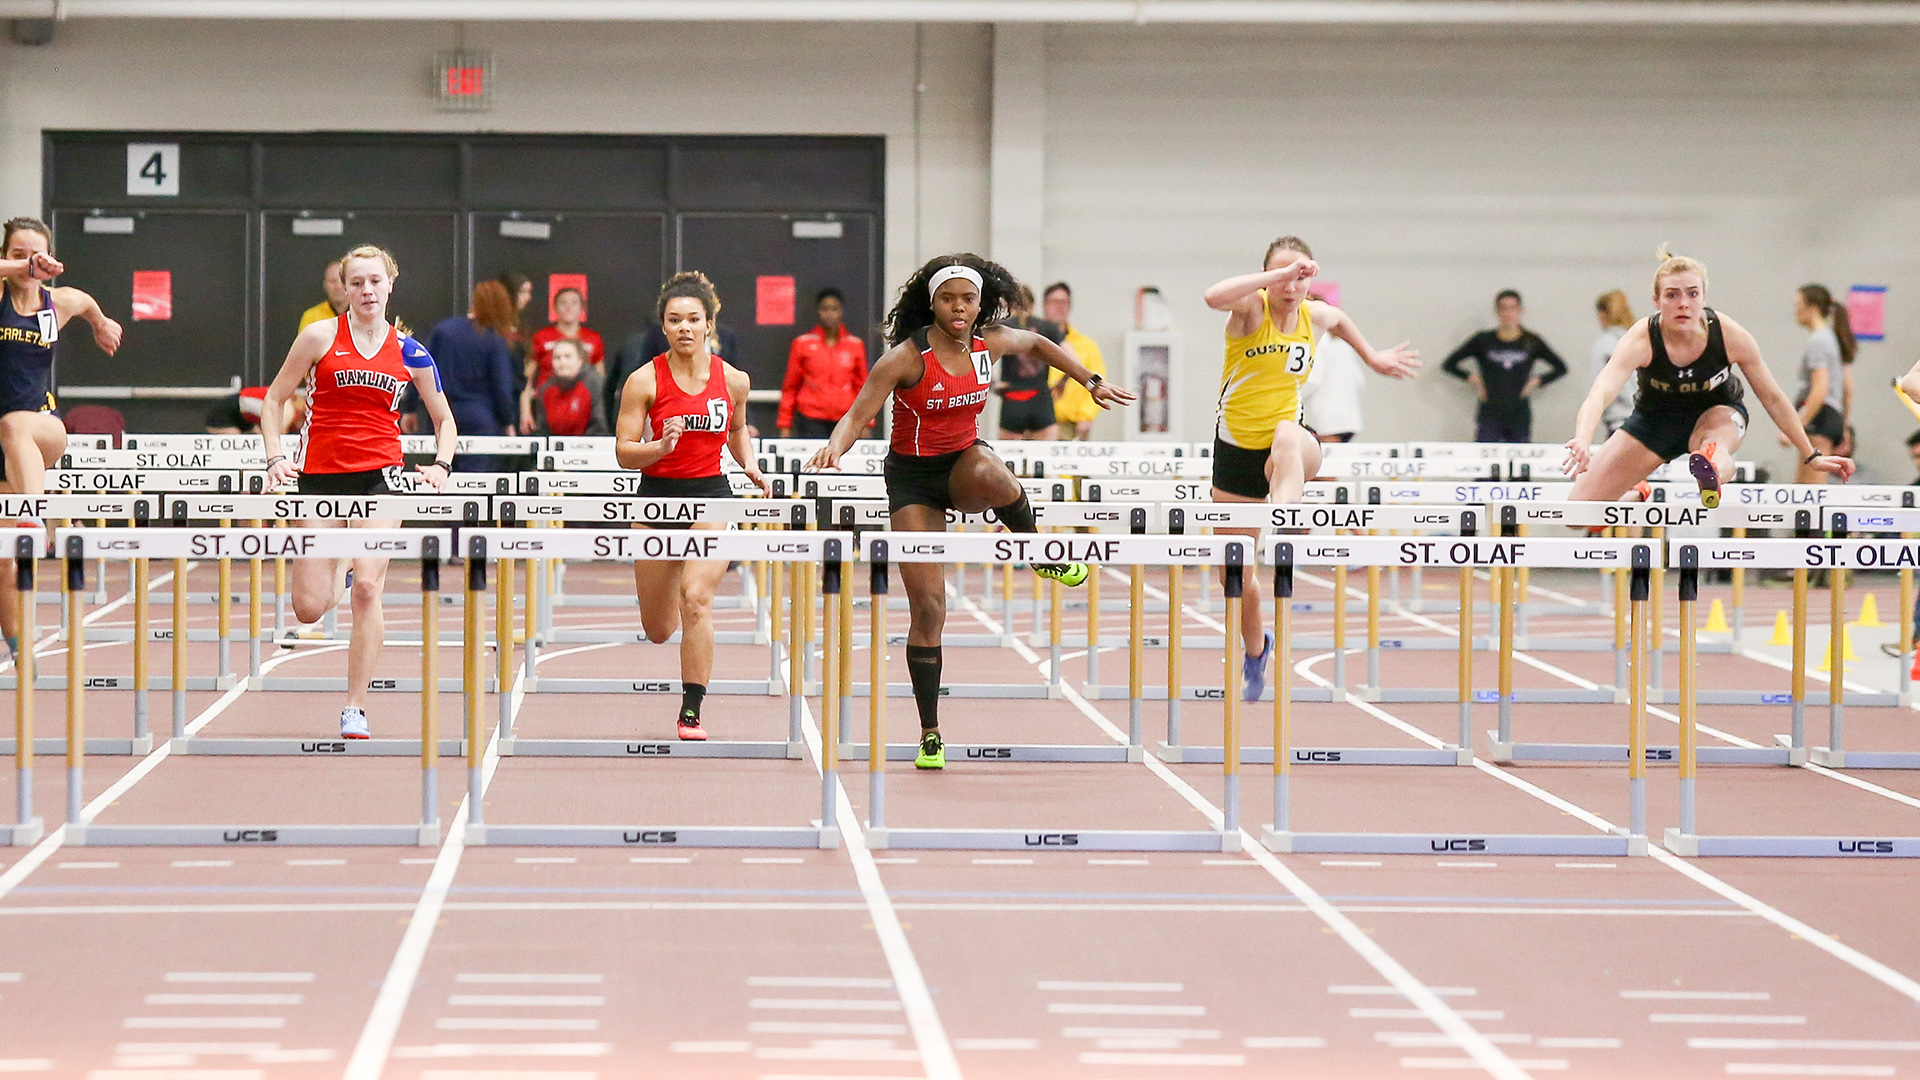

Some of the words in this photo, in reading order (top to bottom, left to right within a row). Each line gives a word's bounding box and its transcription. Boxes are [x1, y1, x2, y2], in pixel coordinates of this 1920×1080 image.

[139, 151, 166, 186] 4
[42, 312, 53, 339] 7
[1290, 346, 1305, 372] 3
[980, 353, 989, 381] 4
[334, 369, 398, 394] HAMLINE
[1679, 380, 1711, 393] OLA
[714, 403, 724, 430] 5
[194, 439, 215, 450] ST.
[220, 439, 260, 450] OLAF
[136, 454, 159, 467] ST.
[166, 454, 212, 467] OLAF
[866, 459, 885, 473] ST
[1109, 461, 1132, 474] ST.
[1139, 461, 1184, 474] OLAF
[1351, 463, 1375, 476] ST.
[1381, 463, 1425, 476] OLAF
[58, 474, 86, 489] ST.
[93, 474, 146, 489] OLAF
[613, 477, 638, 492] ST
[1175, 485, 1202, 499] ST.
[1455, 487, 1482, 501] ST.
[1490, 487, 1542, 501] OLAF
[1740, 488, 1767, 503] ST.
[1775, 489, 1828, 504] OLAF
[0, 500, 48, 517] LAF
[87, 504, 123, 512] UCS
[198, 504, 234, 513] UCS
[274, 500, 306, 518] ST.
[316, 501, 377, 518] OLAF
[417, 506, 452, 514] UCS
[527, 506, 562, 514] UCS
[603, 503, 635, 519] ST.
[644, 503, 706, 520] OLAF
[745, 509, 780, 517] UCS
[866, 510, 890, 518] UC
[1528, 510, 1563, 518] UCS
[1195, 513, 1231, 521] UCS
[1271, 508, 1304, 526] ST.
[1312, 509, 1374, 527] OLAF
[1414, 515, 1449, 523] UCS
[1604, 507, 1637, 524] ST.
[1645, 507, 1708, 525] OLAF
[1748, 514, 1783, 522] UCS
[1858, 517, 1894, 525] UCS
[97, 540, 140, 550] UCS
[191, 535, 229, 555] ST.
[241, 535, 316, 555] OLAF
[364, 541, 407, 550] UCS
[501, 541, 544, 550] UCS
[594, 535, 632, 556] ST.
[643, 536, 718, 557] OLAF
[767, 543, 810, 553] UCS
[902, 545, 945, 554] UCS
[995, 540, 1033, 560] ST.
[1044, 540, 1120, 560] OLAF
[1168, 547, 1211, 557] UCS
[1307, 548, 1350, 557] UCS
[1400, 543, 1439, 564] ST.
[1450, 543, 1525, 564] OLAF
[1574, 550, 1617, 559] UCS
[1712, 550, 1755, 560] UCS
[1806, 545, 1845, 566] ST.
[632, 683, 671, 692] UCS
[301, 742, 346, 753] UCS
[626, 744, 671, 754] UCS
[967, 748, 1011, 758] UCS
[1296, 751, 1341, 762] UCS
[223, 830, 278, 843] UCS
[623, 831, 677, 843] UCS
[1024, 834, 1079, 846] UCS
[1431, 839, 1486, 851] UCS
[1838, 842, 1893, 854] UCS
